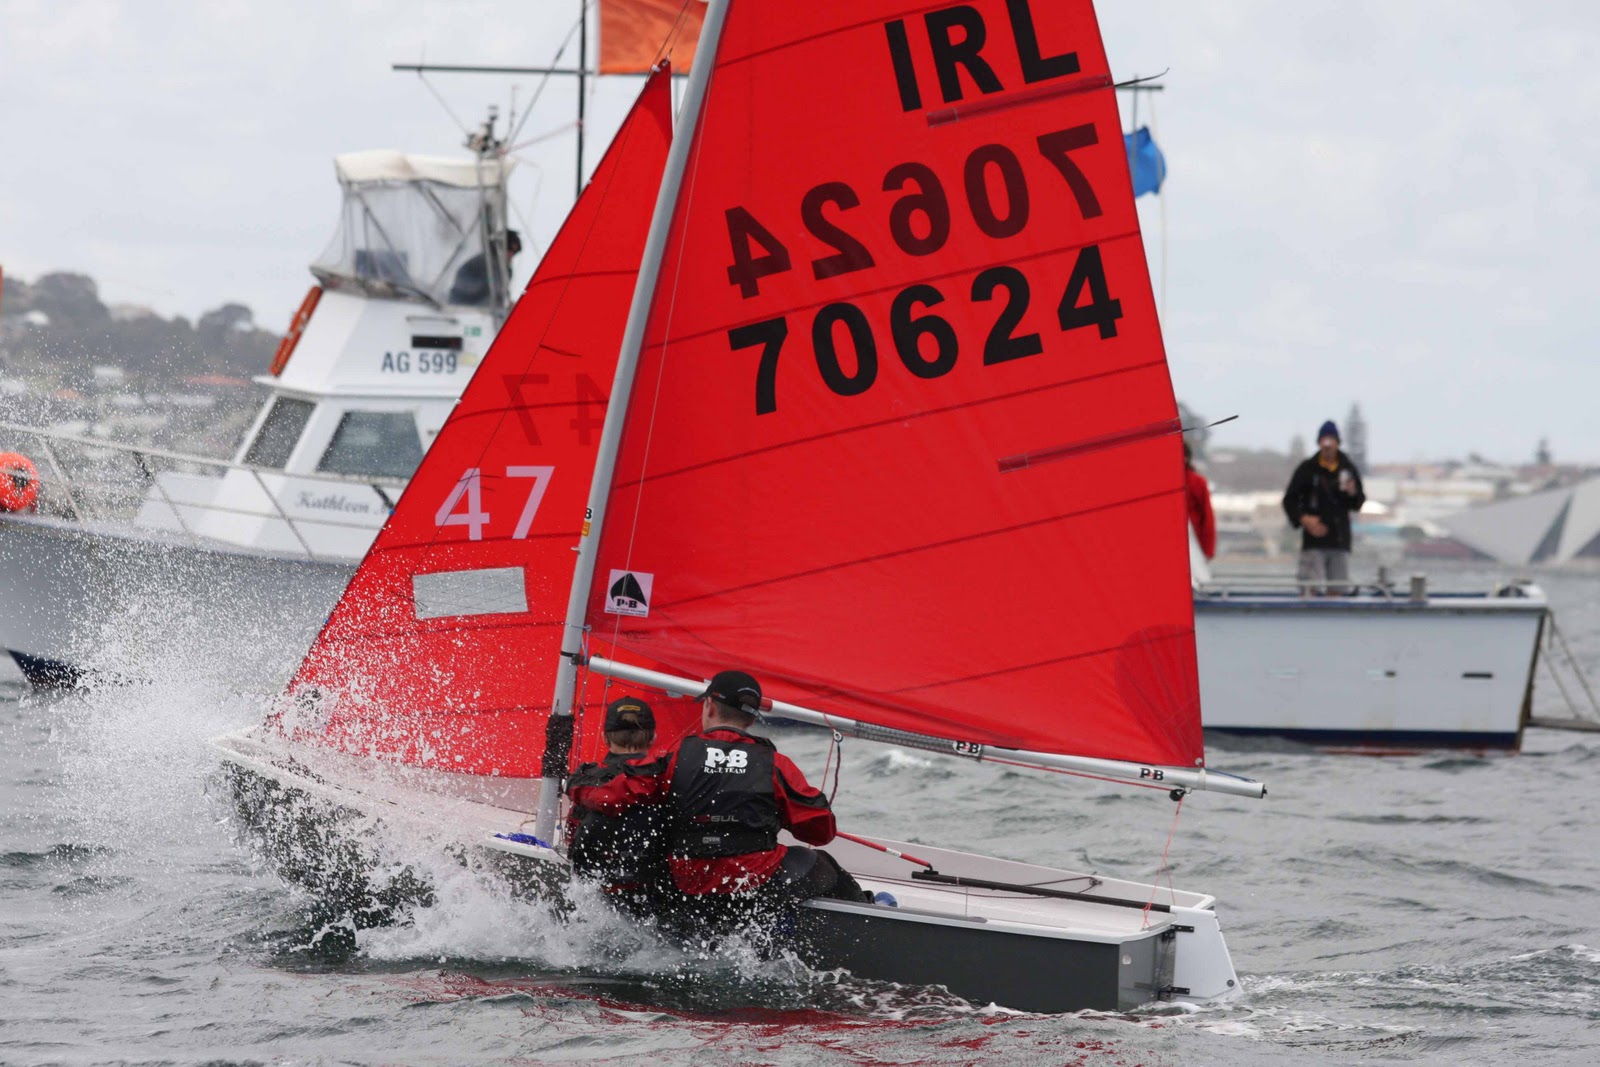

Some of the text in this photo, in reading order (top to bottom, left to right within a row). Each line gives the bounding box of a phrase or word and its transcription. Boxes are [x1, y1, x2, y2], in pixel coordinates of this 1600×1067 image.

[884, 0, 1081, 112] IRL
[728, 244, 1124, 416] 70624
[382, 351, 458, 375] AG 599
[435, 465, 555, 541] 47
[724, 767, 747, 775] TEAM
[710, 815, 740, 823] GUL
